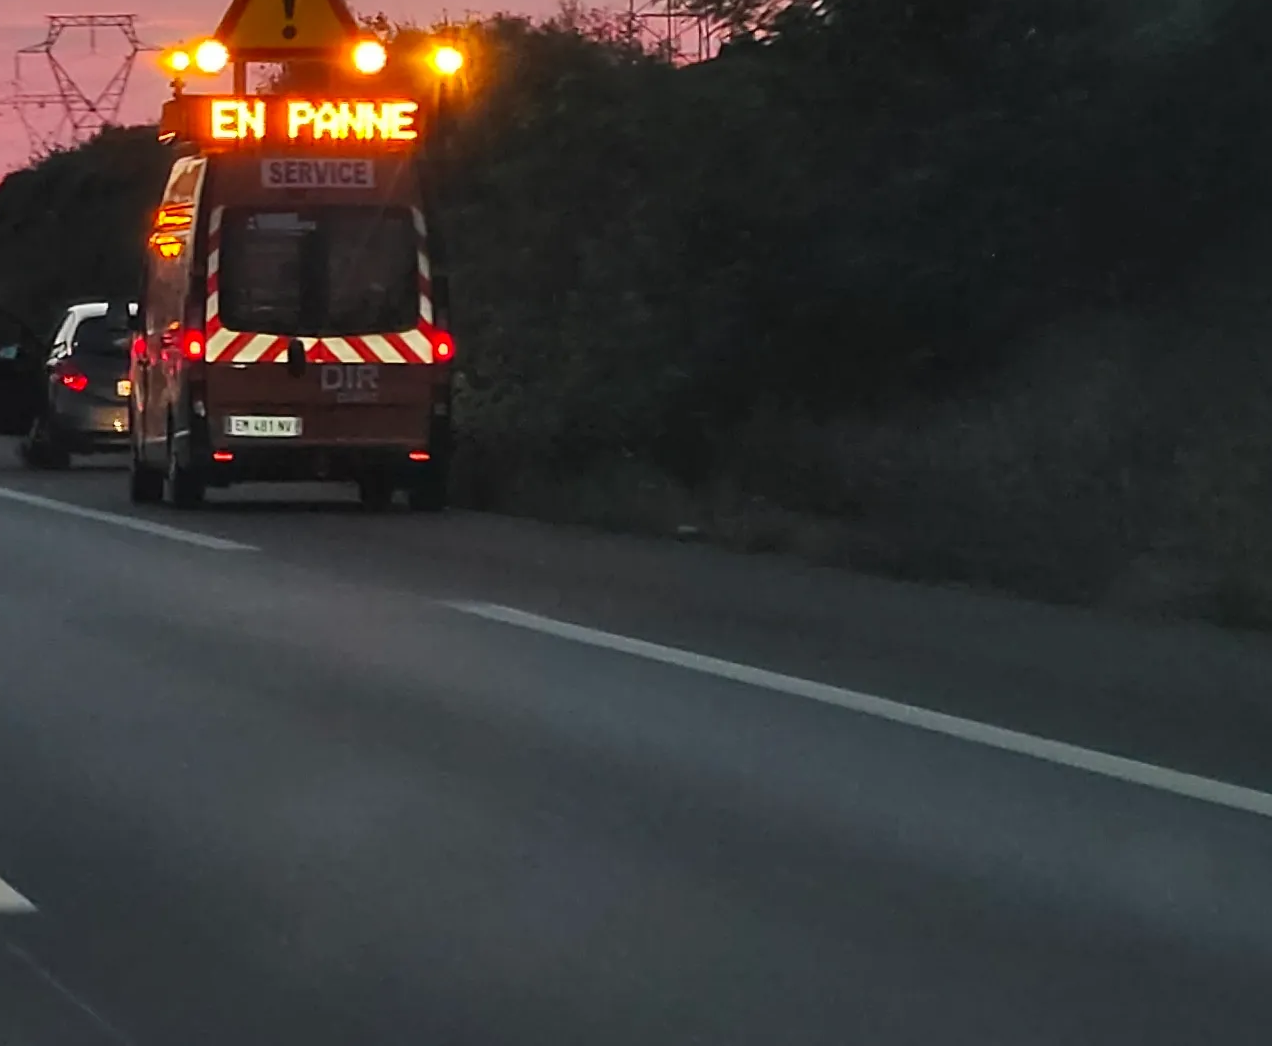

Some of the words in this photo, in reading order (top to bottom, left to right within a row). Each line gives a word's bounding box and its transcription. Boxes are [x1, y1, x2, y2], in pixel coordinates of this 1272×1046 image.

[210, 99, 266, 140] EN
[287, 100, 419, 141] PANNE
[268, 161, 368, 185] SERVICE
[320, 365, 379, 390] DIR
